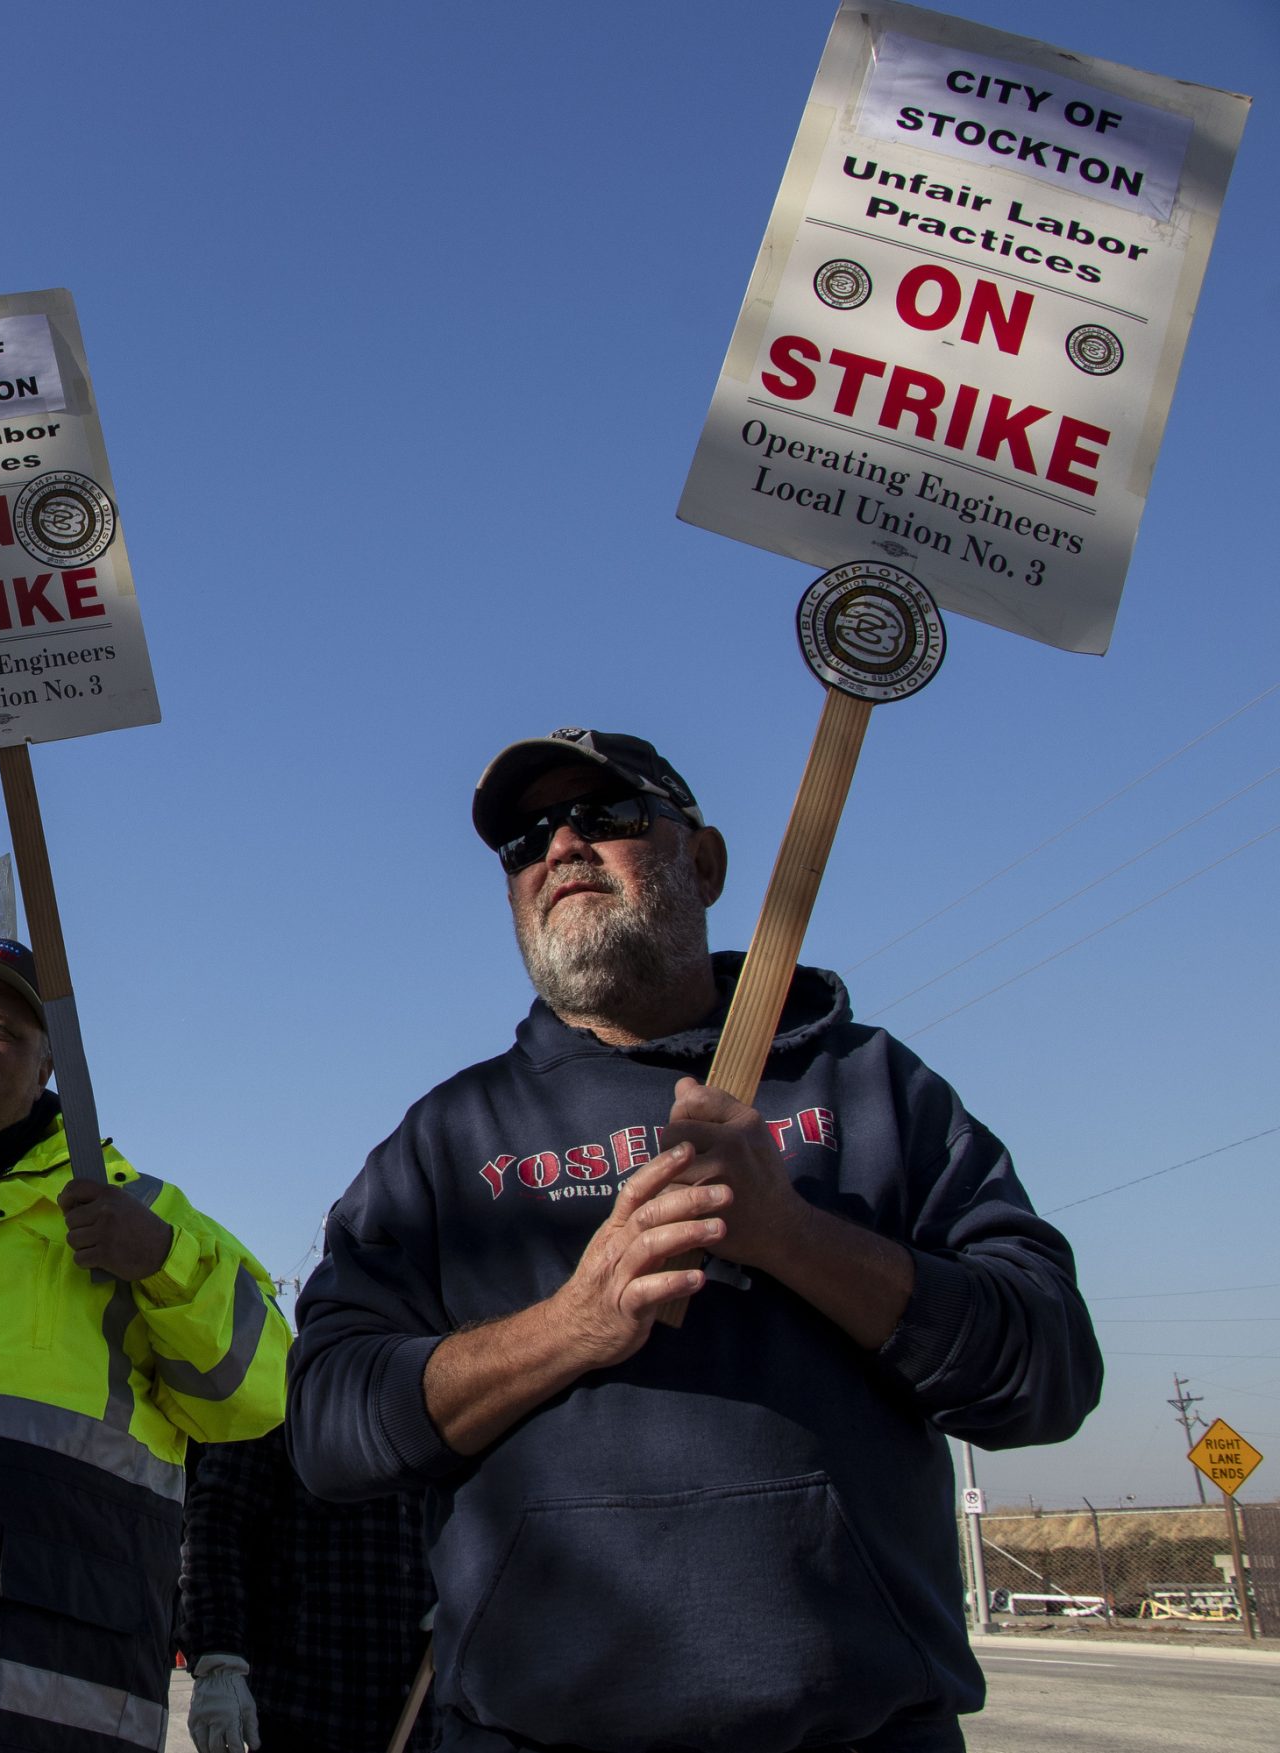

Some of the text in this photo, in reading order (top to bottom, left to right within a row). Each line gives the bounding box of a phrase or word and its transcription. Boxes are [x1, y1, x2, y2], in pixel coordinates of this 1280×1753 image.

[945, 69, 1124, 134] CITY OF
[896, 106, 1145, 197] STOCKTON
[842, 156, 1149, 263] Unfair Labor
[865, 197, 1103, 284] Practices
[895, 264, 1035, 356] ON
[761, 335, 1112, 497] STRIKE
[27, 474, 103, 500] EMPLOYEES
[86, 504, 112, 559] DIVISION
[741, 419, 1085, 555] Operating Engineers
[752, 466, 1047, 588] Local Union No. 3
[801, 565, 940, 695] PUBLIC EMPLOYEES DIVISION
[44, 679, 85, 703] No.
[89, 674, 103, 696] 3
[548, 1184, 613, 1202] WORLD
[1206, 1439, 1241, 1449] RIGHT
[1209, 1453, 1242, 1465] LANE
[1211, 1467, 1245, 1479] ENDS
